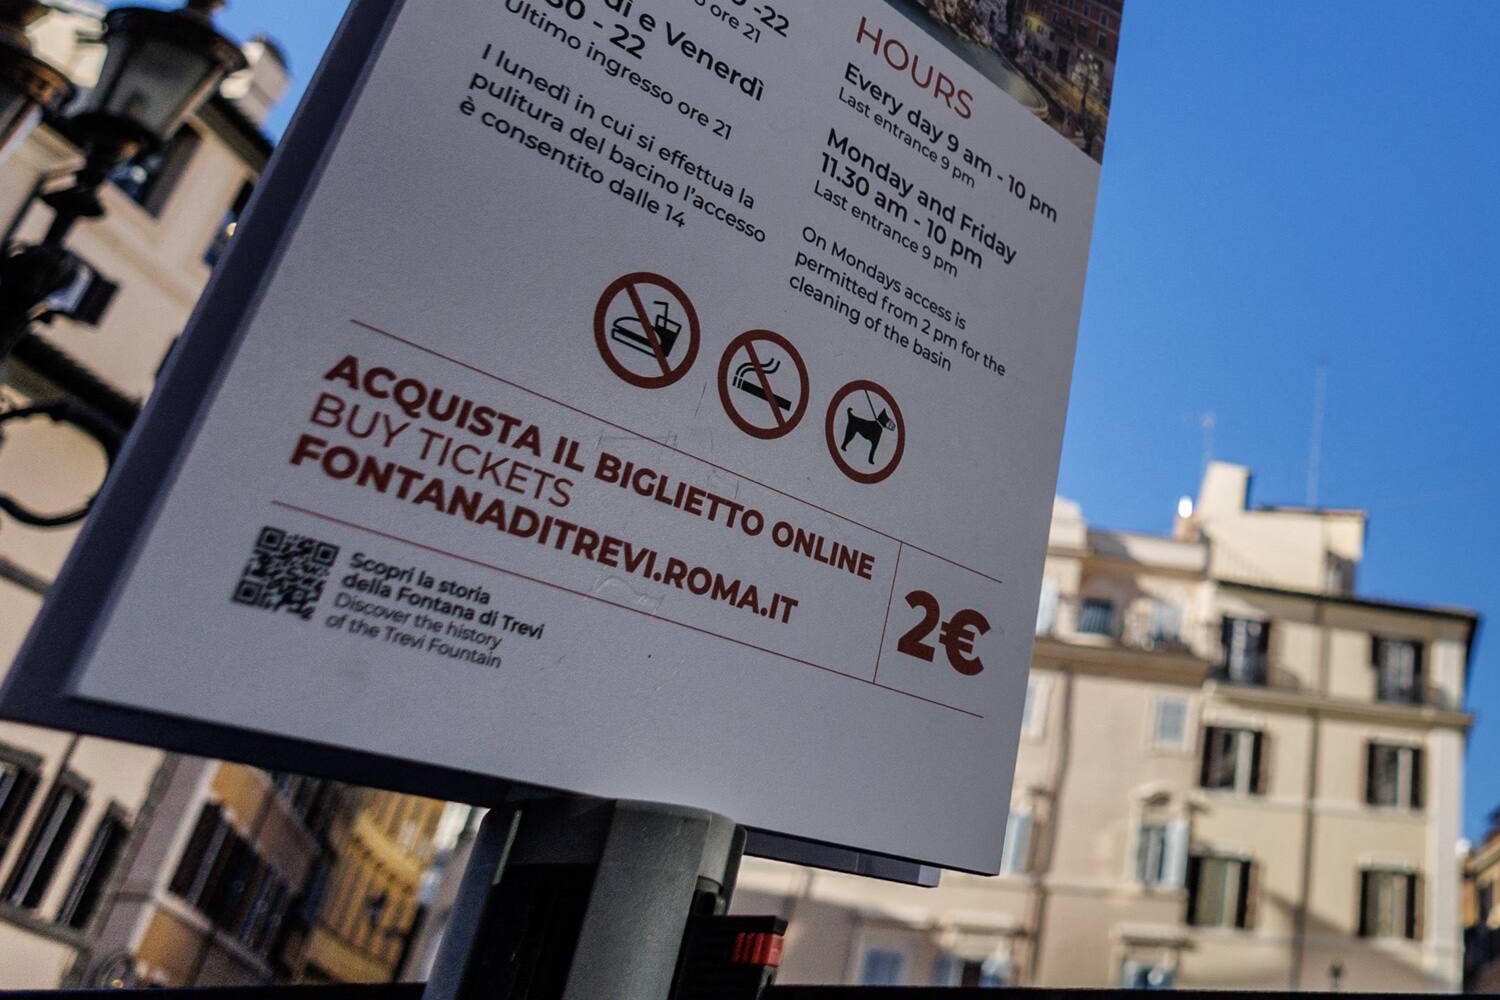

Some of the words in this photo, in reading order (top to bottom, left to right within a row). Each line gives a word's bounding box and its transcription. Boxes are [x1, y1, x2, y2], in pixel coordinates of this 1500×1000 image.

[609, 24, 646, 59] 22
[639, 10, 656, 31] e
[665, 21, 764, 100] Venerdì
[710, 2, 739, 29] ore
[742, 23, 761, 43] 21
[856, 16, 974, 119] HOURS
[469, 72, 564, 132] pulitura
[570, 125, 605, 154] del
[609, 144, 678, 195] bacino
[481, 44, 492, 60] I
[495, 51, 570, 104] lunedì
[574, 94, 595, 120] in
[601, 113, 634, 141] cui
[637, 135, 655, 152] si
[659, 148, 733, 197] effettua
[739, 187, 754, 209] la
[586, 42, 673, 105] ingresso
[678, 100, 709, 126] ore
[713, 120, 732, 140] 21
[838, 86, 870, 118] Last
[873, 112, 938, 162] entrance
[941, 156, 951, 171] 9
[952, 166, 976, 188] pm
[460, 95, 475, 116] è
[482, 110, 603, 184] consentito
[610, 176, 659, 214] dalle
[666, 204, 686, 228] 14
[844, 62, 903, 116] Every
[907, 109, 943, 144] day
[948, 134, 959, 152] 9
[963, 149, 992, 178] am
[1008, 174, 1026, 200] 10
[1029, 193, 1058, 223] pm
[813, 180, 847, 212] Last
[851, 206, 919, 253] entrance
[921, 245, 931, 261] 9
[933, 254, 958, 278] pm
[820, 152, 870, 197] 11.30
[874, 191, 908, 222] am
[926, 218, 947, 244] 10
[950, 238, 983, 269] pm
[827, 128, 914, 198] Monday
[917, 189, 956, 224] and
[959, 213, 1017, 265] Friday
[789, 275, 860, 325] cleaning
[864, 316, 882, 333] of
[884, 323, 909, 348] the
[913, 340, 951, 372] basin
[795, 250, 878, 305] permitted
[881, 296, 918, 328] from
[921, 320, 932, 335] 2
[933, 328, 958, 350] pm
[961, 340, 981, 362] for
[983, 350, 1006, 377] the
[802, 226, 827, 251] On
[831, 242, 902, 294] Mondays
[904, 286, 952, 323] access
[954, 312, 966, 330] is
[310, 392, 410, 448] BUY
[418, 427, 575, 508] TICKETS
[324, 355, 541, 457] ACQUISTA
[552, 436, 585, 472] IL
[594, 452, 764, 537] BIGLIETTO
[772, 521, 875, 580] ONLINE
[289, 434, 799, 624] FONTANADITREVI.ROMA.IT
[350, 552, 415, 583] Scopri
[418, 571, 434, 588] la
[439, 580, 490, 604] storia
[325, 614, 348, 628] of
[349, 618, 380, 638] the
[385, 627, 425, 647] Trevi
[428, 638, 502, 668] Fountain
[335, 592, 411, 624] Discover
[413, 614, 443, 632] the
[446, 622, 502, 650] history
[342, 573, 392, 598] della
[397, 587, 474, 620] Fontana
[480, 610, 499, 626] di
[502, 614, 544, 639] Trevi
[897, 589, 991, 676] 2€
